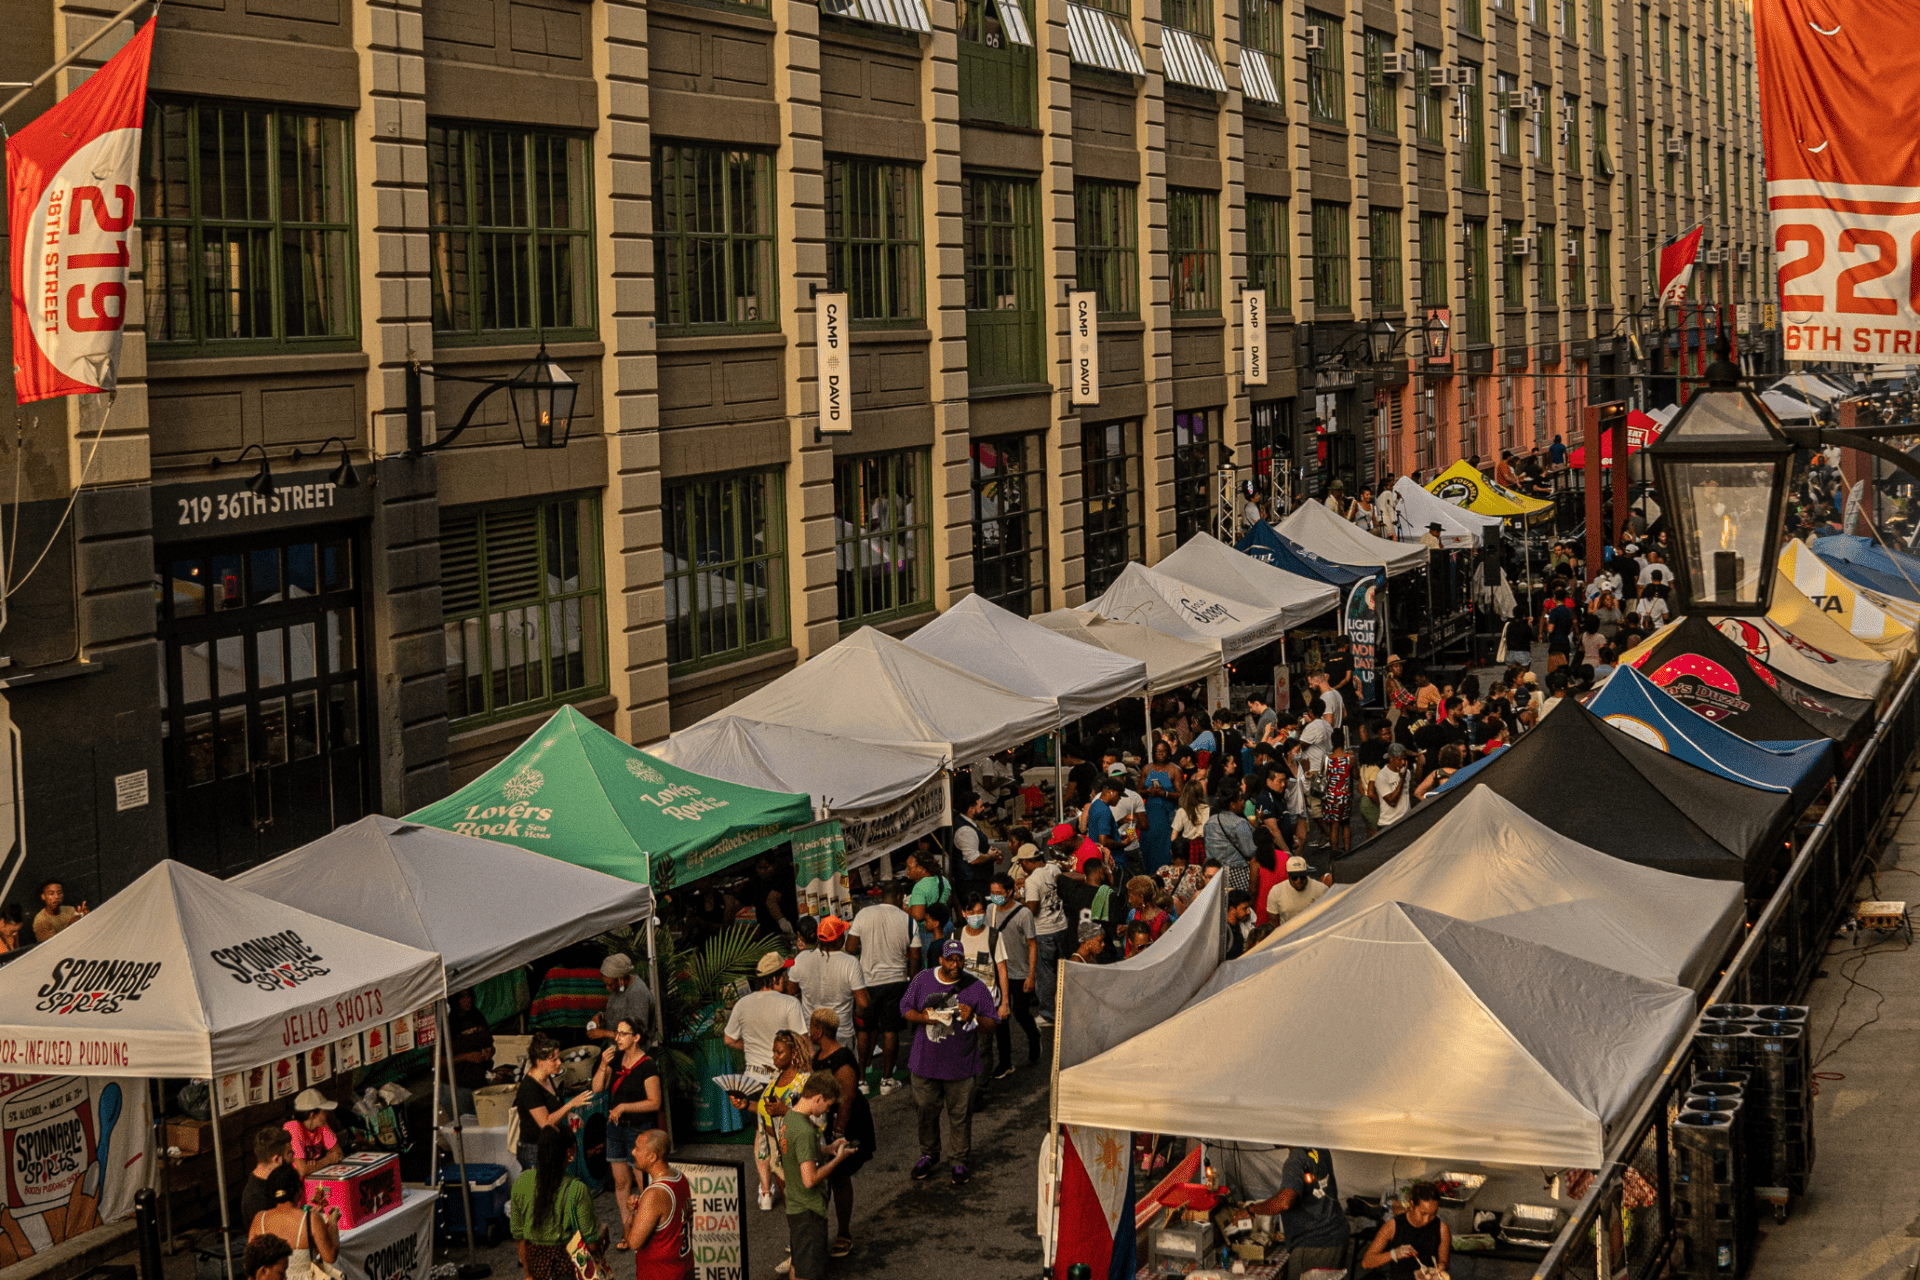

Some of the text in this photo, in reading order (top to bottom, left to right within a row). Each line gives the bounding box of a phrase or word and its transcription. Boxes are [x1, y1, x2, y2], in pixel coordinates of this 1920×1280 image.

[44, 189, 64, 335] 36TH STREET
[66, 184, 135, 333] 219
[1775, 223, 1920, 316] 22
[1078, 300, 1090, 396] CAMP DAVID
[1249, 297, 1260, 377] CAMP DAVID
[1784, 325, 1841, 351] 6TH
[826, 303, 841, 421] CAMP DAVID
[178, 482, 337, 525] 219 36TH STREET
[1348, 618, 1375, 631] LIGHT
[1350, 632, 1375, 643] YOUR
[1352, 644, 1375, 656] MON
[1362, 670, 1375, 683] UP
[1695, 684, 1751, 712] Duzin
[640, 782, 702, 808] Lovers
[464, 801, 553, 821] Lovers
[662, 799, 709, 821] Rock
[452, 819, 547, 838] Rock Sea
[523, 830, 552, 839] Moss
[210, 929, 323, 984] SPOONABLE
[37, 957, 162, 1001] SPOONABLE
[282, 1006, 329, 1047] JELLO
[336, 988, 384, 1029] SHOTS
[79, 1040, 129, 1067] PUDDING
[8, 1111, 18, 1122] 5%
[19, 1104, 43, 1120] ALCOHOL
[49, 1095, 64, 1110] MUST
[65, 1091, 73, 1102] BE
[16, 1117, 83, 1172] SPOONABLE
[24, 1184, 42, 1195] BOOZY
[42, 1178, 66, 1194] PUDDING
[703, 1197, 738, 1213] NEW
[364, 1232, 418, 1280] SPOONABLE
[706, 1266, 742, 1280] NEW
